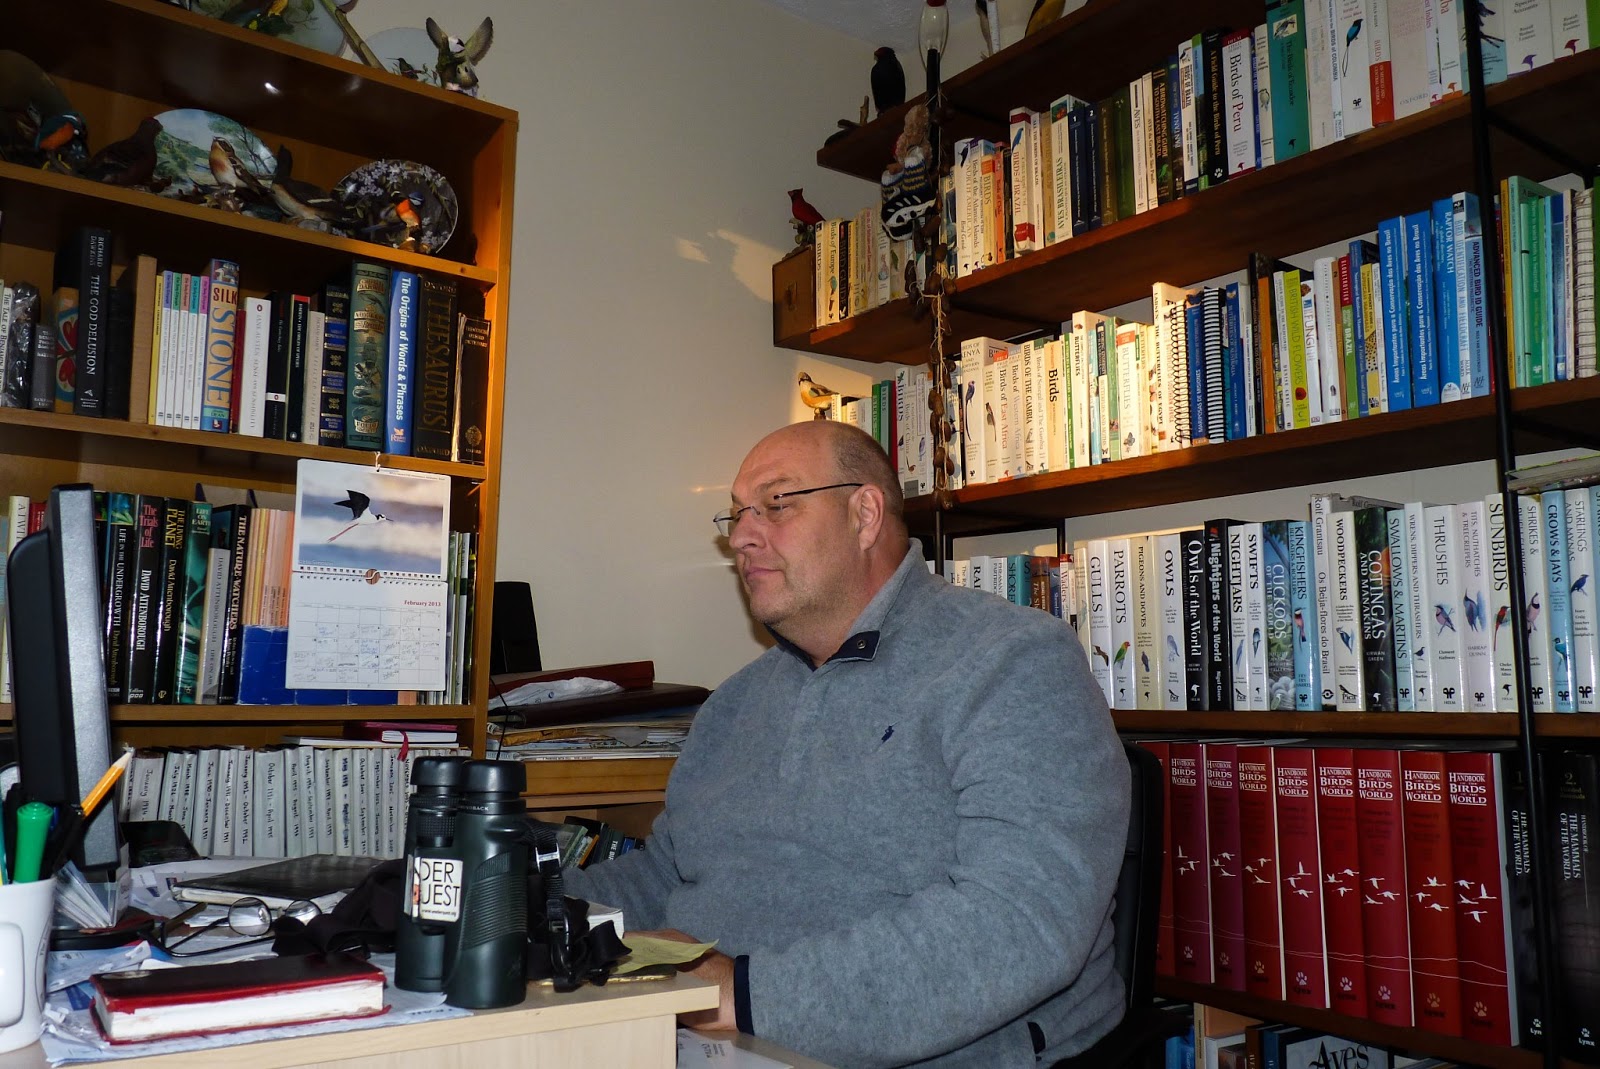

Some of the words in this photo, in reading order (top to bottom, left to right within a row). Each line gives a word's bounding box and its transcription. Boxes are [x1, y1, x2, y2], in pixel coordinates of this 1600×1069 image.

[1230, 54, 1242, 87] Birds
[1231, 88, 1243, 101] of
[1232, 101, 1243, 132] Peru
[829, 250, 837, 273] Europe
[1445, 244, 1454, 274] WATCH
[1472, 241, 1480, 277] ADVANCED
[90, 275, 100, 295] THE
[213, 287, 238, 305] SILK
[401, 277, 411, 294] The
[1473, 279, 1481, 296] BIRD
[89, 298, 99, 320] GOD
[399, 295, 410, 328] Origins
[1474, 297, 1481, 305] ID
[1475, 307, 1483, 327] GUIDE
[399, 330, 408, 341] of
[1291, 320, 1301, 342] WILD
[1304, 314, 1314, 349] FUNGI
[1344, 328, 1352, 355] BRAZIL
[86, 323, 98, 375] DELUSION
[206, 307, 236, 405] STONE
[398, 343, 408, 372] Words
[423, 297, 452, 427] THESAURUS
[1024, 367, 1031, 378] OF
[1293, 345, 1303, 385] FLOWERS
[398, 373, 406, 381] &
[999, 369, 1008, 389] Birds
[1048, 368, 1059, 402] Birds
[1121, 347, 1131, 409] BUTTERFLIES
[396, 383, 407, 421] Phrases
[1000, 392, 1008, 401] of
[1000, 403, 1009, 423] East
[1001, 424, 1010, 449] Africa
[139, 515, 158, 527] Trials
[143, 505, 157, 515] The
[177, 509, 185, 524] THE
[1470, 511, 1478, 527] TITS,
[118, 528, 127, 542] LIFE
[144, 528, 152, 537] of
[164, 508, 178, 548] PLANET
[238, 516, 247, 536] THE
[1316, 517, 1325, 555] Grantsau
[1527, 506, 1538, 545] SHRIKES
[1547, 504, 1560, 547] CROWS
[1575, 501, 1587, 552] STARLINGS
[140, 537, 155, 548] Life
[175, 525, 184, 549] LIVING
[1462, 519, 1471, 568] TREECREEPERS
[1489, 503, 1509, 592] SUNBIRDS
[1187, 540, 1204, 583] Owls
[1247, 534, 1259, 590] SWIFTS
[1335, 518, 1348, 601] WOODPECKERS
[1389, 518, 1404, 586] SWALLOWS
[1409, 545, 1418, 573] DIPPERS
[1433, 516, 1449, 586] THRUSHES
[1472, 529, 1481, 577] NUTHATCHES
[1551, 548, 1561, 557] &
[168, 559, 177, 580] David
[1164, 550, 1174, 597] OWLS
[1208, 543, 1222, 601] Nightjars
[1230, 534, 1243, 613] NIGHTJARS
[1295, 526, 1307, 600] KINGFISHERS
[1360, 552, 1368, 576] AND
[1549, 559, 1563, 583] JAYS
[140, 570, 152, 591] DAVID
[1089, 556, 1103, 613] GULLS
[1113, 550, 1127, 624] PARROTS
[1318, 572, 1327, 584] Os
[1412, 575, 1420, 592] AND
[113, 562, 126, 626] UNDERGROWTH
[1190, 585, 1199, 598] of
[1272, 564, 1287, 639] CUCKOOS
[1368, 550, 1387, 639] COTINGAS
[1394, 590, 1404, 599] &
[162, 581, 176, 631] Attenborough
[404, 600, 427, 608] February
[1190, 600, 1200, 619] the
[1212, 604, 1220, 615] of
[1318, 586, 1329, 634] Beija-flores
[1361, 580, 1372, 640] MANAKINS
[136, 593, 148, 651] ATTENBOROUGH
[1212, 616, 1221, 632] the
[1413, 593, 1422, 639] THRASHERS
[1190, 621, 1202, 656] World
[1395, 603, 1407, 658] MARTINS
[1213, 634, 1222, 662] World
[1321, 636, 1330, 648] do
[1322, 650, 1330, 674] Brasil
[1278, 768, 1308, 777] HANDBOOK
[1278, 777, 1308, 786] BIRDS
[1320, 768, 1352, 776] HANDBOOK
[1320, 777, 1353, 786] BIRDS
[1358, 769, 1392, 779] HANDBOOK
[1404, 770, 1440, 780] HANDBOOK
[1449, 772, 1485, 782] HANDBOOK
[1278, 787, 1309, 796] WORLD
[1320, 787, 1353, 796] WORLD
[1359, 780, 1393, 789] BIRDS
[1359, 789, 1393, 799] WORLD
[1405, 781, 1441, 791] BIRDS
[1450, 783, 1486, 793] BIRDS
[1406, 791, 1442, 801] WORLD
[1450, 794, 1487, 804] WORLD
[1560, 812, 1568, 825] OF
[1569, 813, 1578, 832] THE
[1561, 826, 1569, 841] THE
[1570, 833, 1581, 879] MAMMALS
[1578, 1037, 1595, 1046] Lynx
